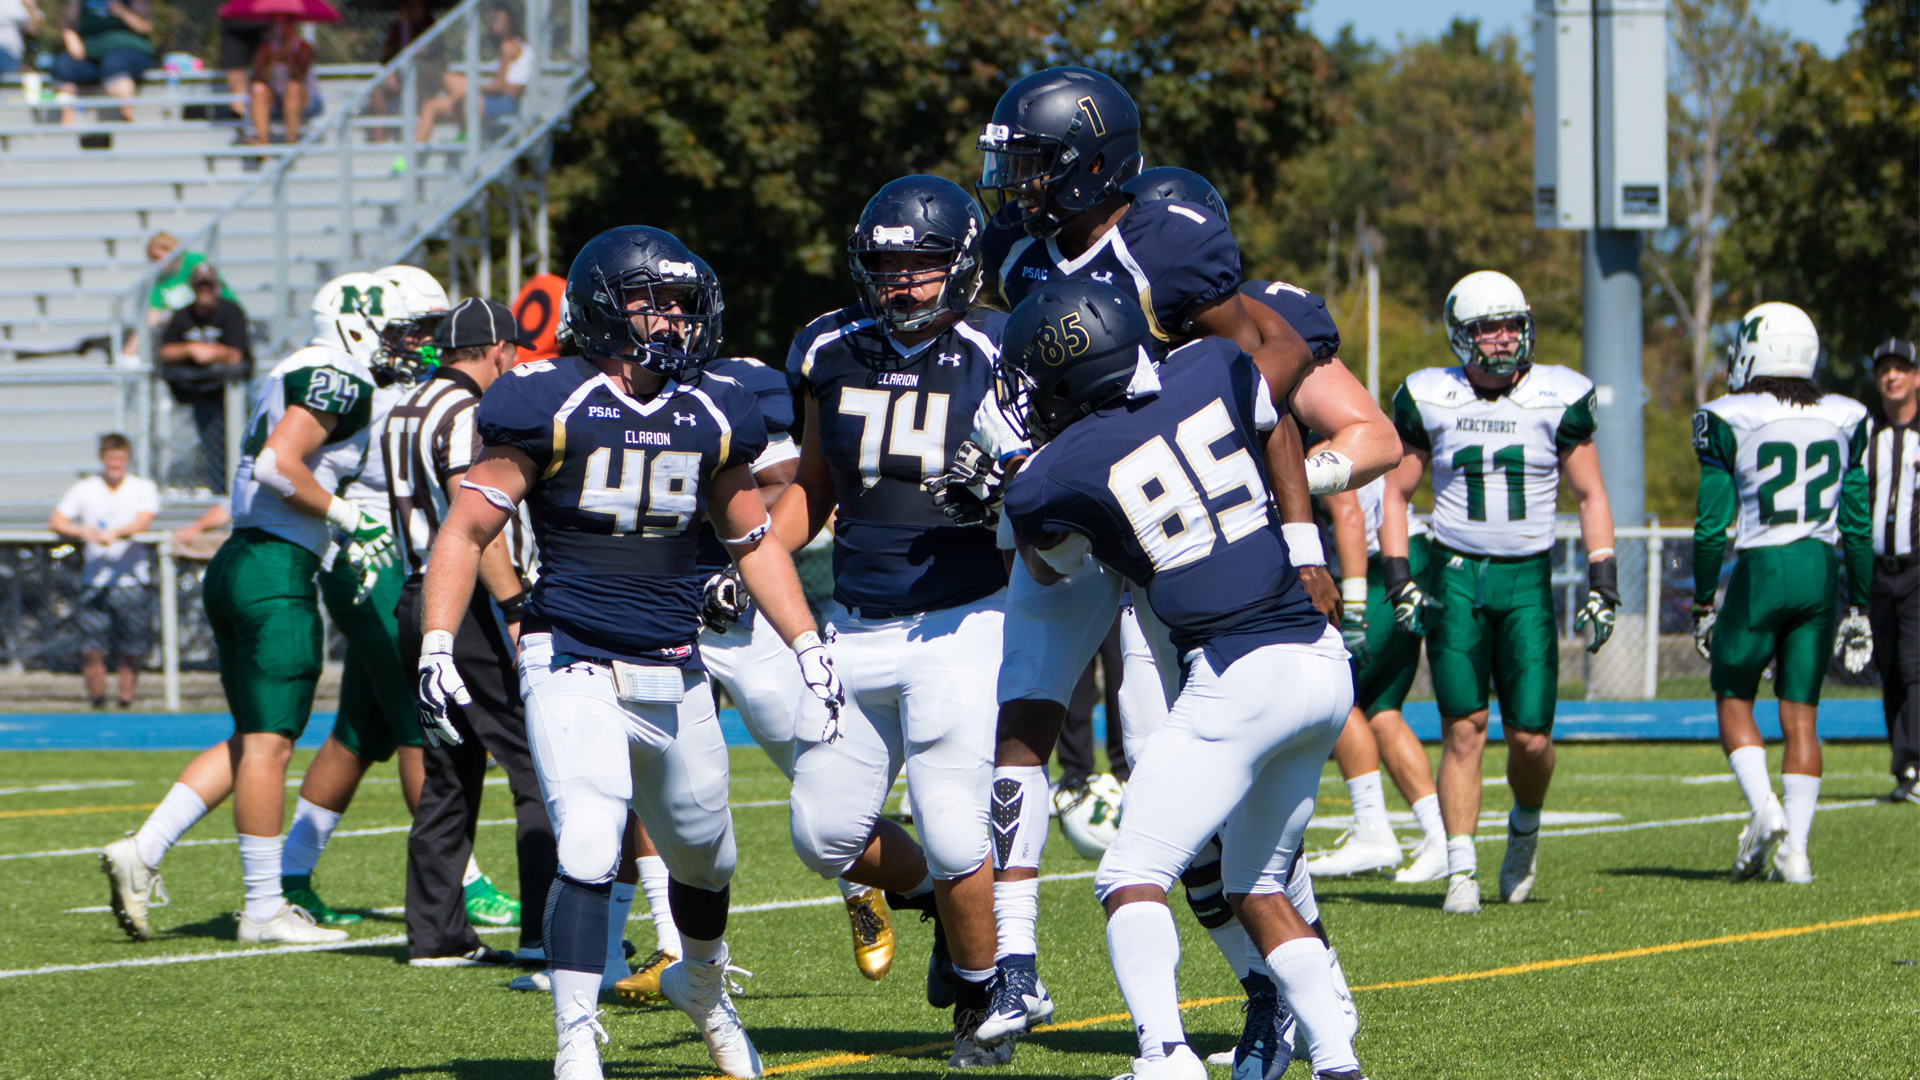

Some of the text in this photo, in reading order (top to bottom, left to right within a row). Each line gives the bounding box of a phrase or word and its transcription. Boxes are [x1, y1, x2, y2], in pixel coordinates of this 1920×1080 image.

[1077, 95, 1106, 138] 1
[1021, 265, 1049, 281] PSAC
[340, 285, 384, 317] M
[1037, 311, 1090, 367] 85
[305, 367, 360, 415] 24
[877, 372, 920, 387] CLARION
[1539, 389, 1559, 399] PSAC
[587, 405, 621, 419] PSAC
[1455, 417, 1518, 435] MERCYHURST
[625, 429, 671, 446] CLARION
[838, 386, 950, 492] 74
[578, 446, 703, 538] 49
[1107, 396, 1270, 574] 85
[1452, 443, 1527, 523] 11
[1756, 438, 1842, 526] 22
